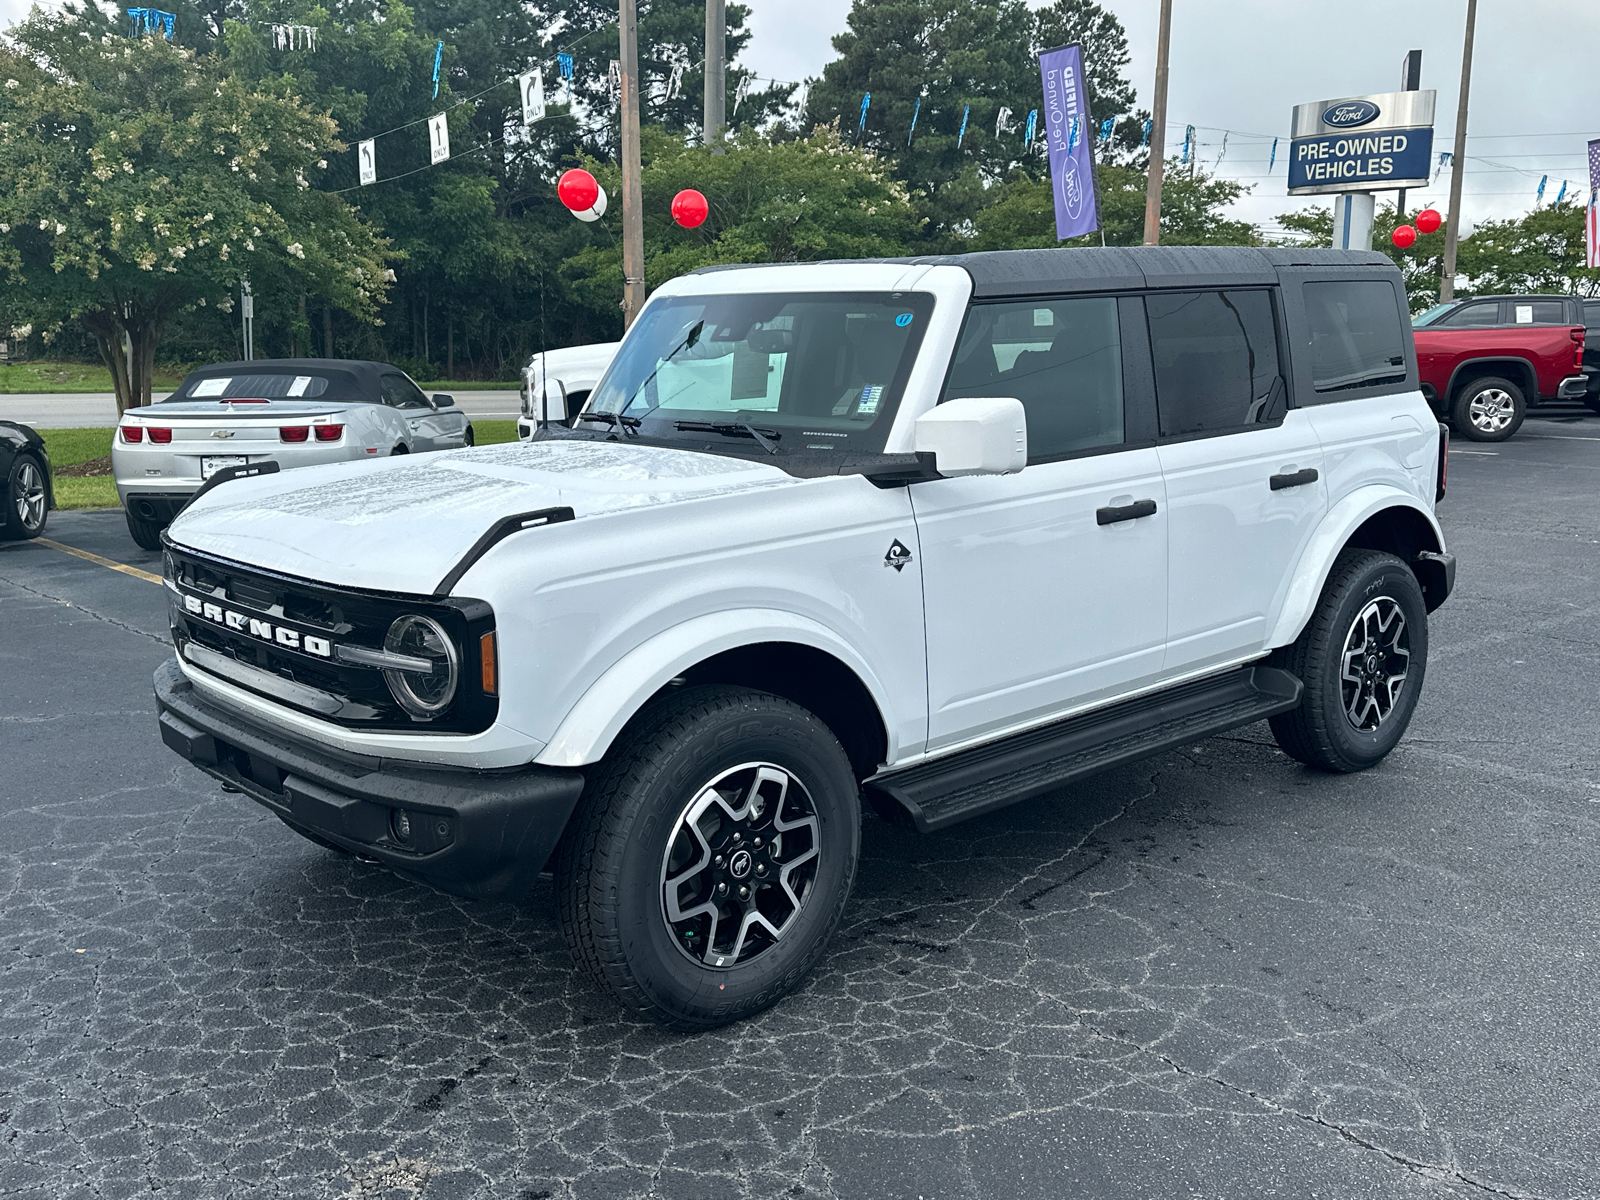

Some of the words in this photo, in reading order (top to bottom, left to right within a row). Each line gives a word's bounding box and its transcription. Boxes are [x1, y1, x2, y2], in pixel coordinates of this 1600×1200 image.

[526, 104, 542, 119] ONLY
[1332, 105, 1364, 123] Ford
[433, 146, 447, 159] ONLY
[1298, 135, 1408, 161] PRE-OWNED
[362, 170, 373, 180] ONLY
[1305, 157, 1394, 180] VEHICLES
[899, 314, 911, 324] 17
[185, 594, 331, 657] BRONCO
[638, 720, 762, 850] DUELER
